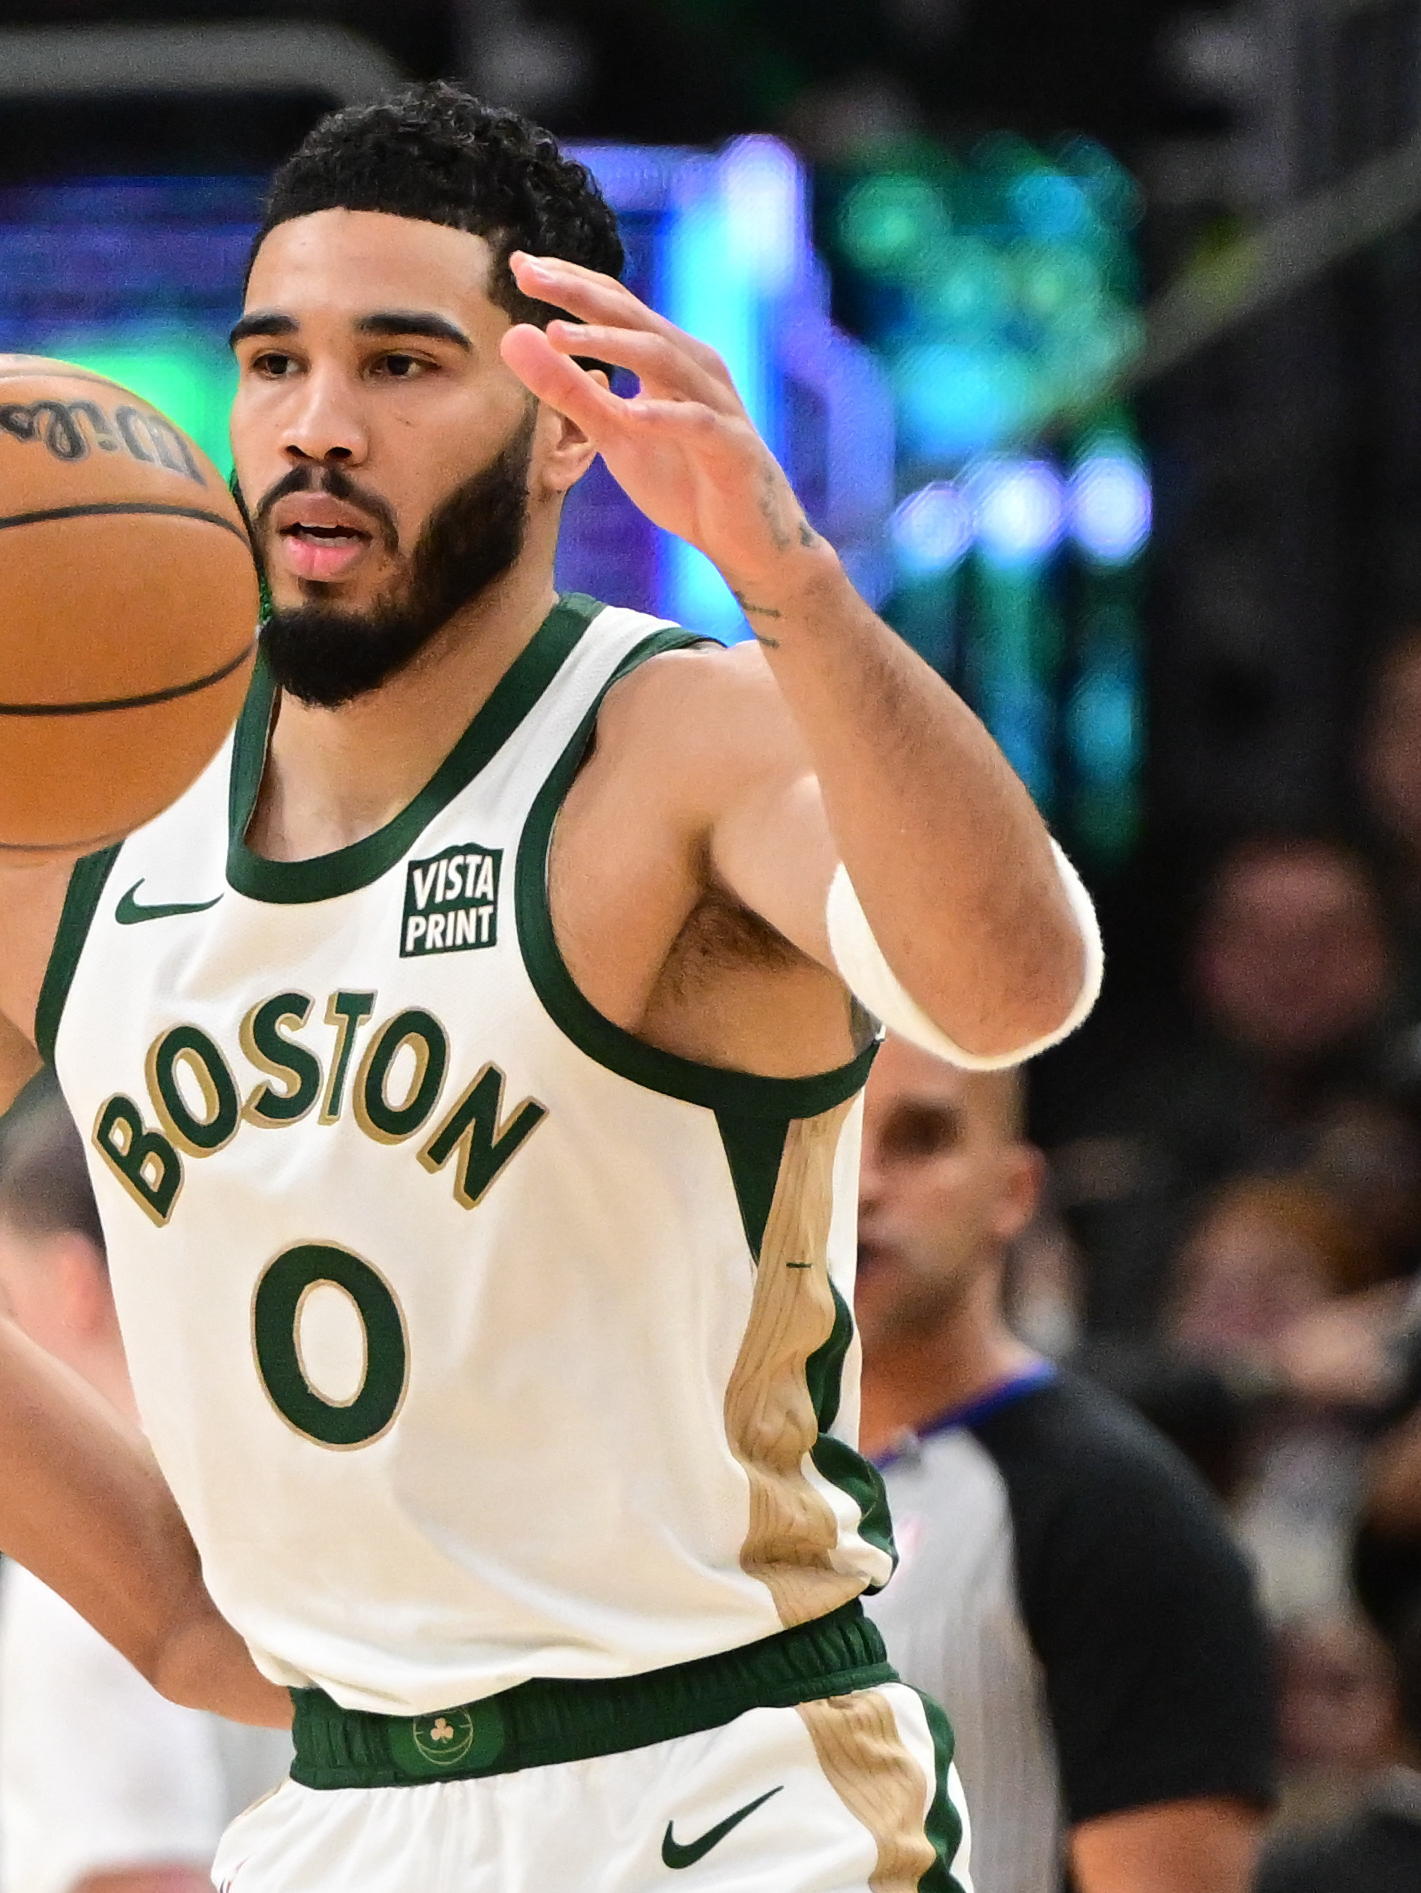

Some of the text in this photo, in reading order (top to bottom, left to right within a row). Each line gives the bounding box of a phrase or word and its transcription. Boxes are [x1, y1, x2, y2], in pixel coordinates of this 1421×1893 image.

[405, 904, 495, 953] PRINT
[412, 854, 495, 911] VISTA
[91, 988, 549, 1228] BOSTON
[249, 1238, 411, 1452] 0
